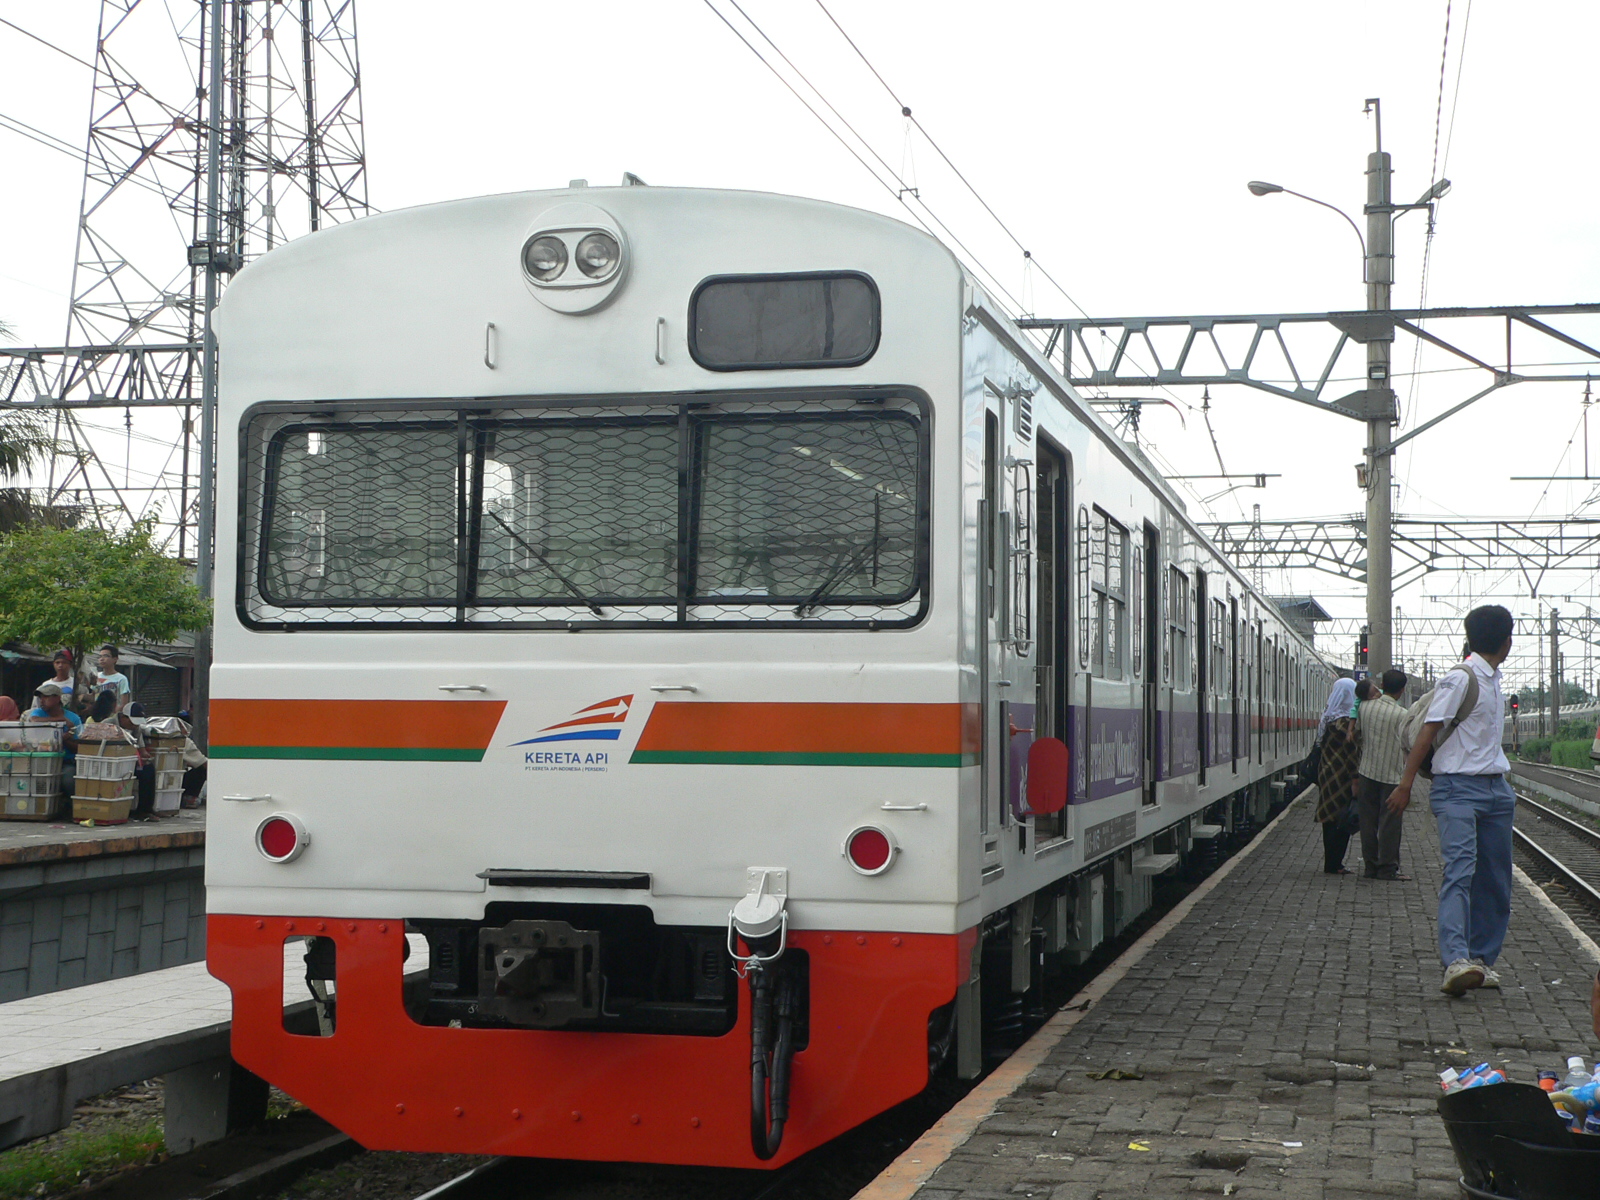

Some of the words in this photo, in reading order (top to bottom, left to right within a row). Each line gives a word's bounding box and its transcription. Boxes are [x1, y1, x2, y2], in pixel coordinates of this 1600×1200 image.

[1358, 672, 1365, 681] 5
[525, 752, 581, 764] KERETA
[584, 752, 608, 764] API
